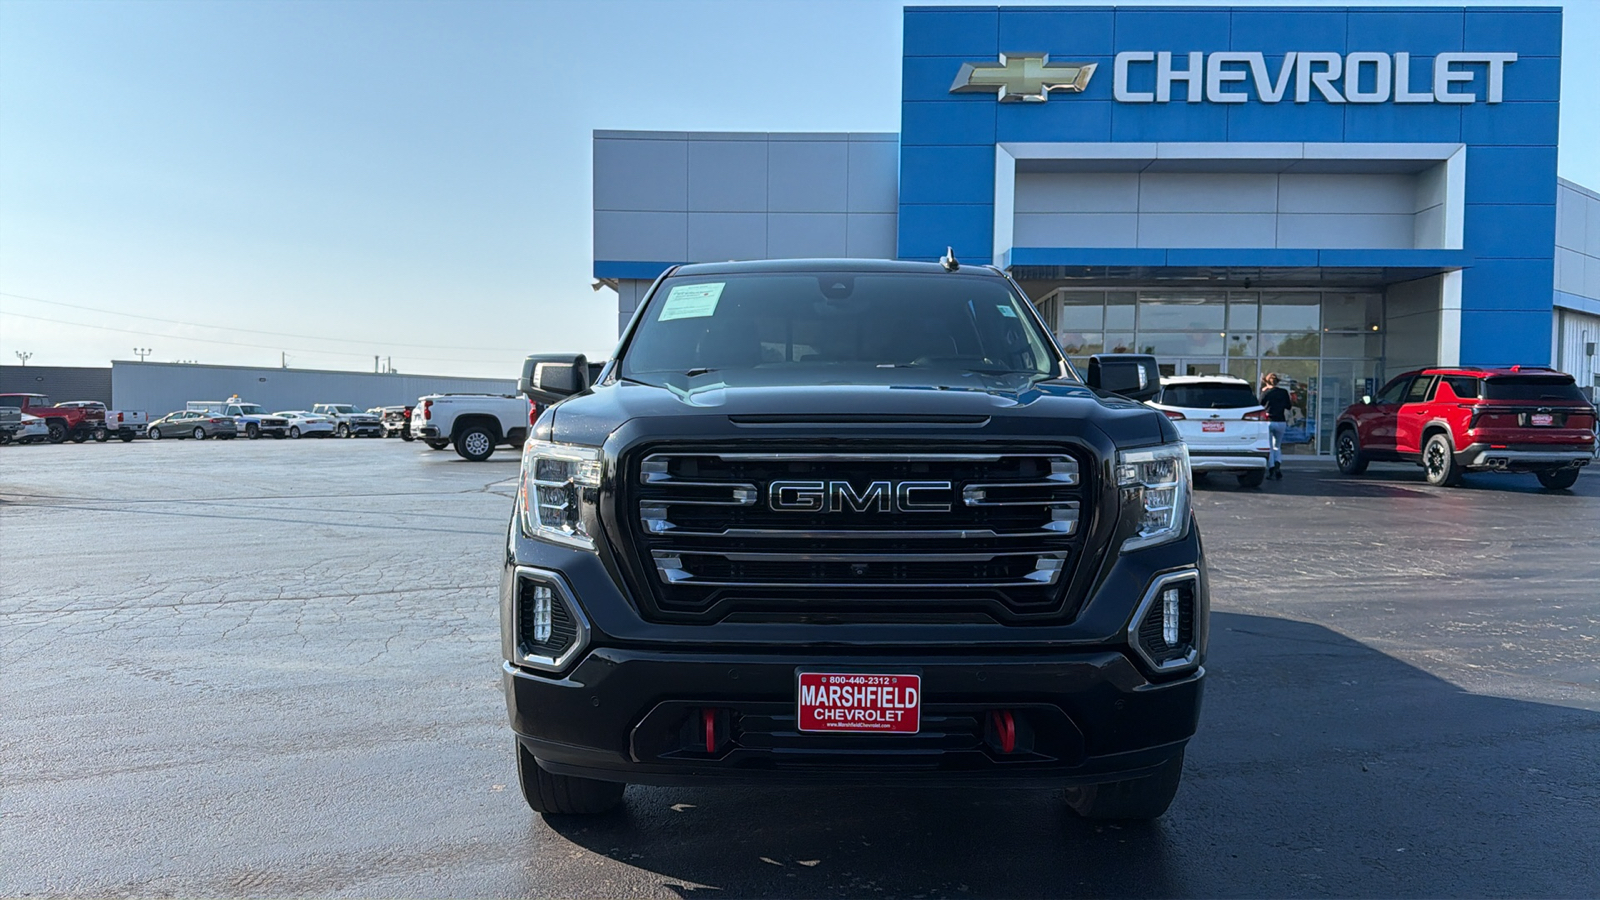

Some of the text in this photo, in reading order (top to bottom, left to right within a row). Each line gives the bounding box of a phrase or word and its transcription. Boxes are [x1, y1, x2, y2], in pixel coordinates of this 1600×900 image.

[1113, 51, 1518, 104] CHEVROLET
[769, 480, 952, 512] GMC
[829, 676, 890, 685] 800-440-2312
[801, 685, 918, 709] MARSHFIELD
[813, 708, 905, 722] CHEVROLET
